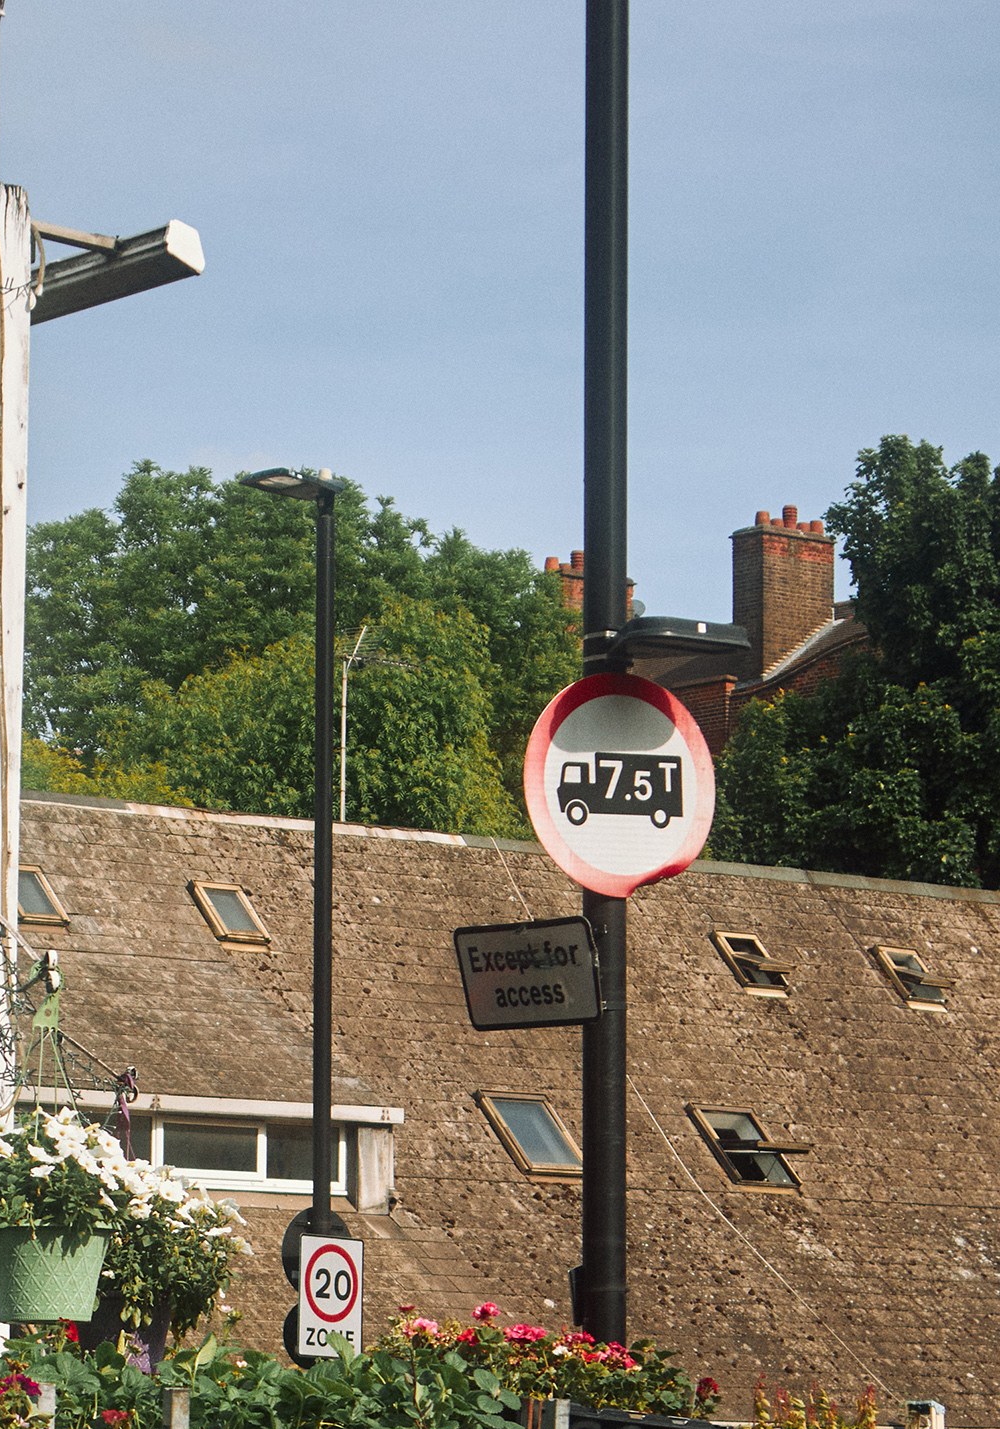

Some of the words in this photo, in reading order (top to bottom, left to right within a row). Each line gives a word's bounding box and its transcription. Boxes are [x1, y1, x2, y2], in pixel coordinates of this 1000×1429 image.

[467, 943, 537, 975] Except
[543, 941, 579, 967] for
[495, 983, 566, 1008] access
[315, 1268, 351, 1301] 20
[306, 1327, 355, 1349] ZOE
